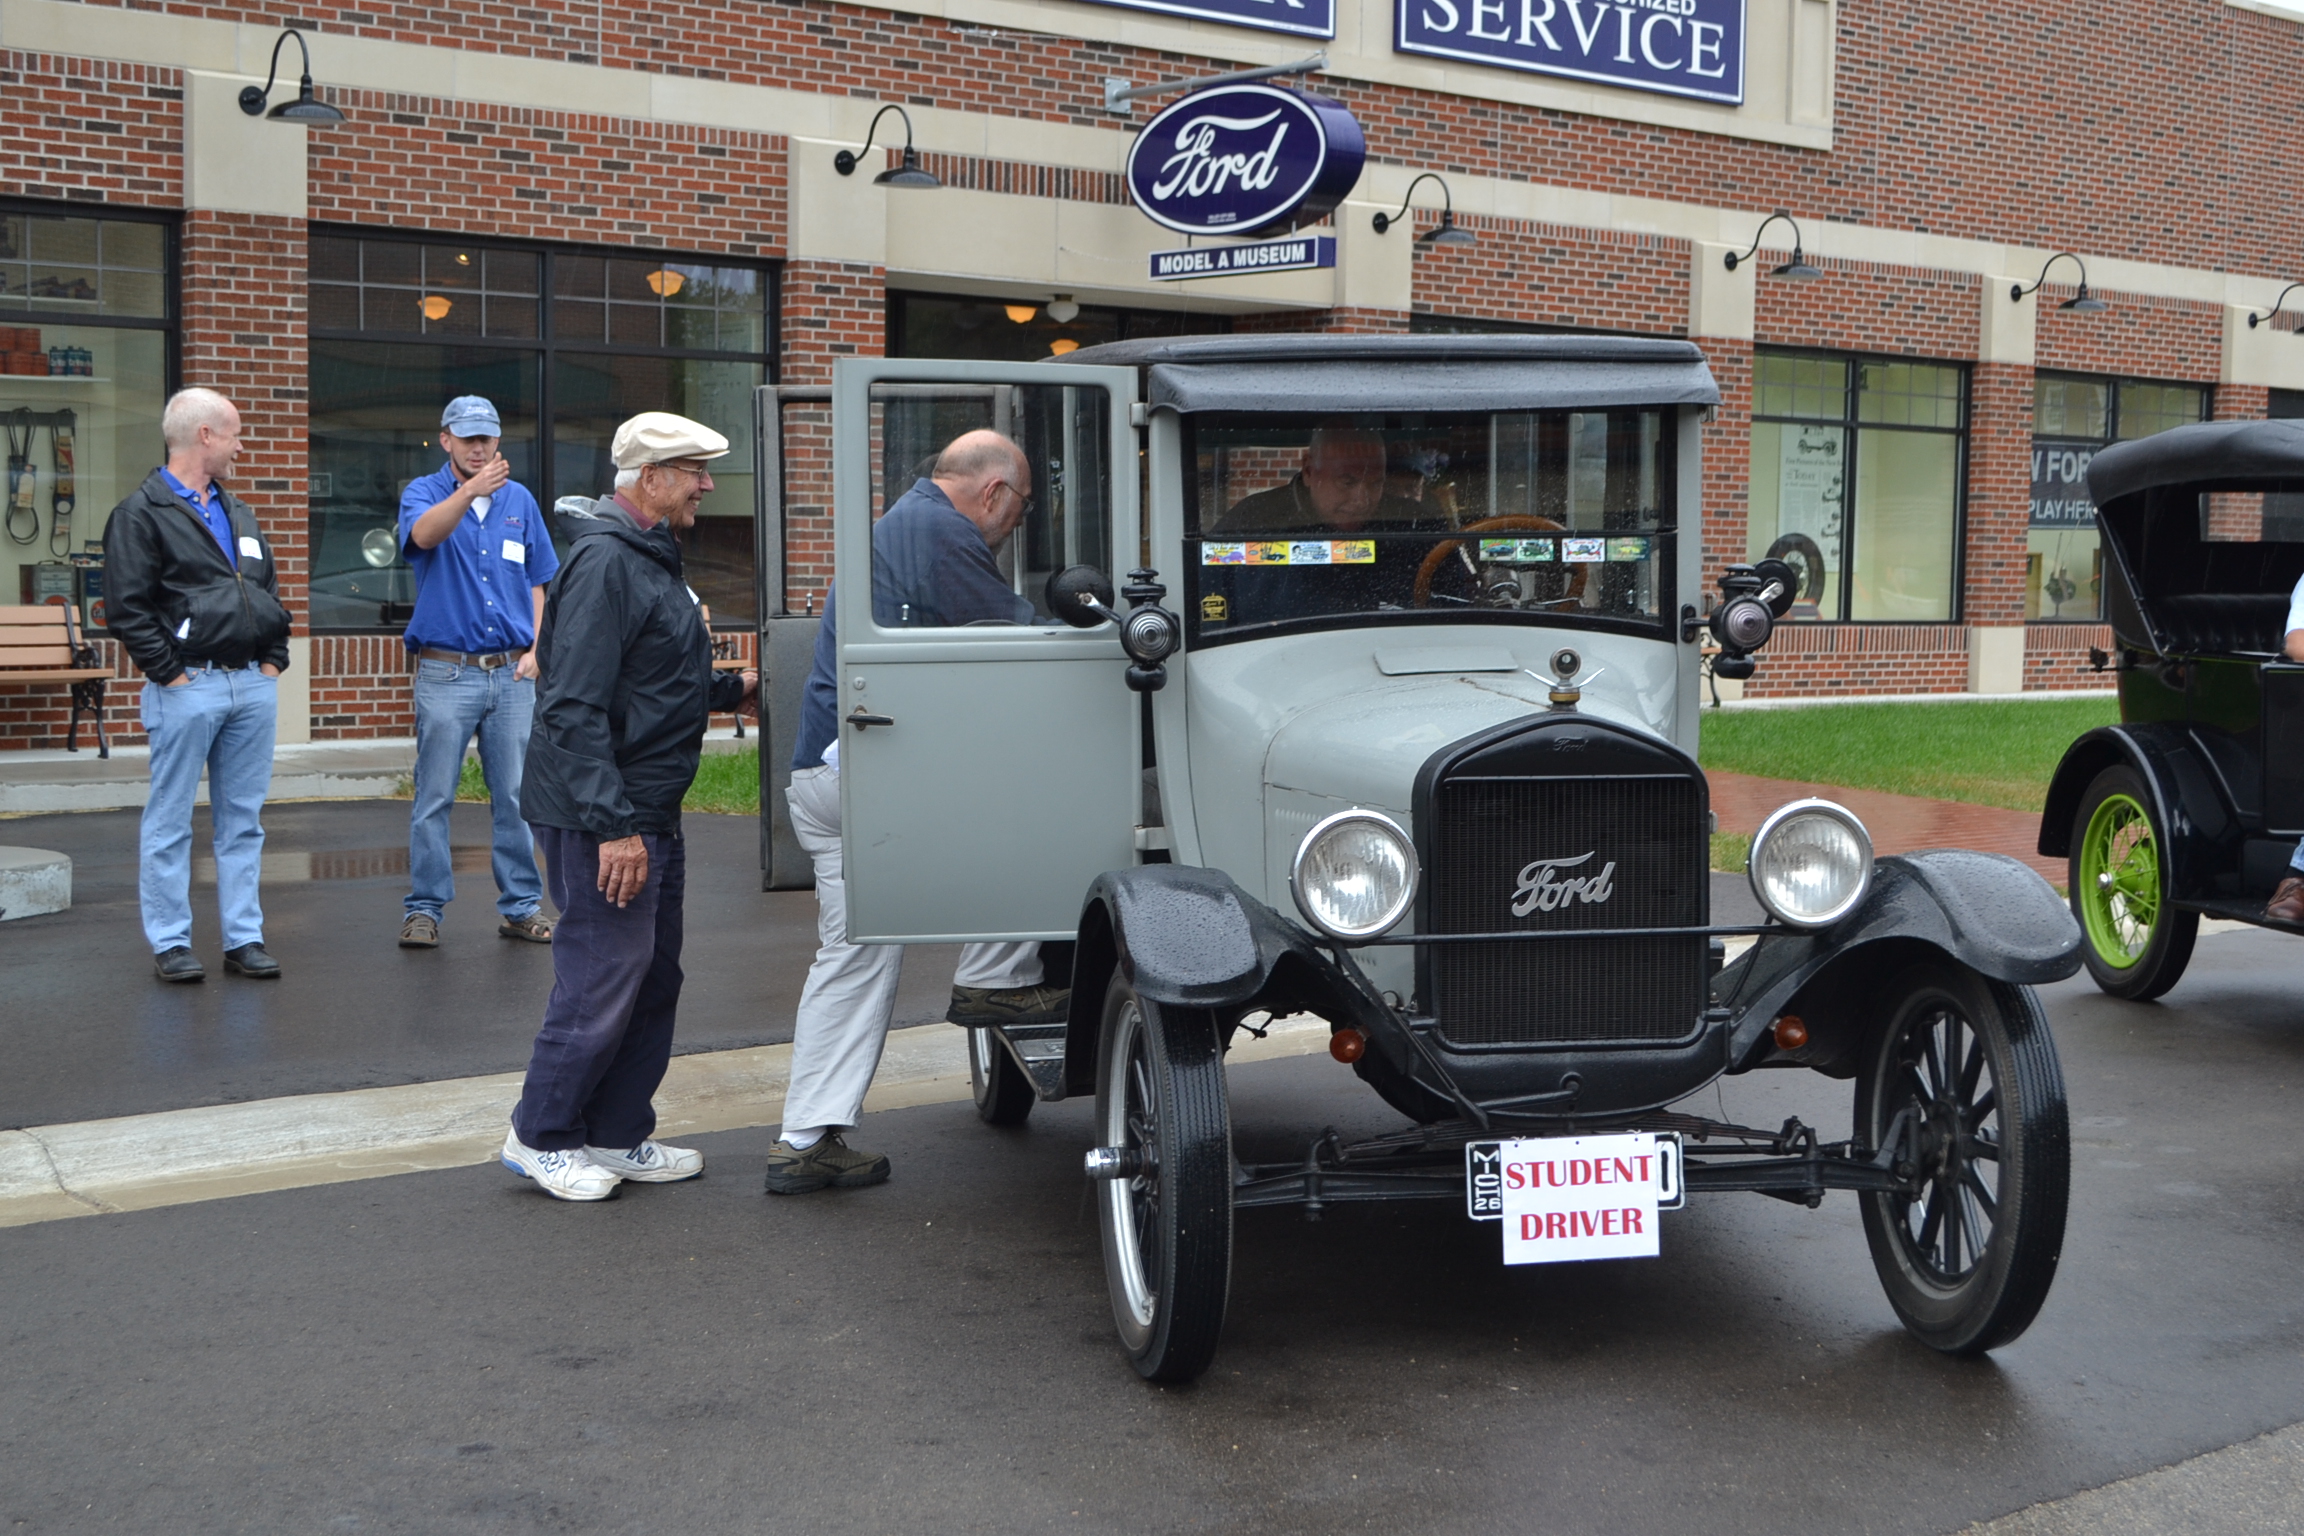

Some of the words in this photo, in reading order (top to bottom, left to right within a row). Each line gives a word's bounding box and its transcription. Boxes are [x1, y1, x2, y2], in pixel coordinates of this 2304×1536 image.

[1422, 0, 1727, 78] SERVICE
[1152, 108, 1290, 201] Ford
[1159, 251, 1214, 274] MODEL
[1217, 253, 1230, 268] A
[1233, 244, 1306, 267] MUSEUM
[1553, 736, 1589, 751] Ford
[1511, 850, 1616, 917] Ford
[1506, 1154, 1653, 1190] STUDENT
[1474, 1197, 1501, 1211] 26
[1520, 1207, 1643, 1241] DRIVER
